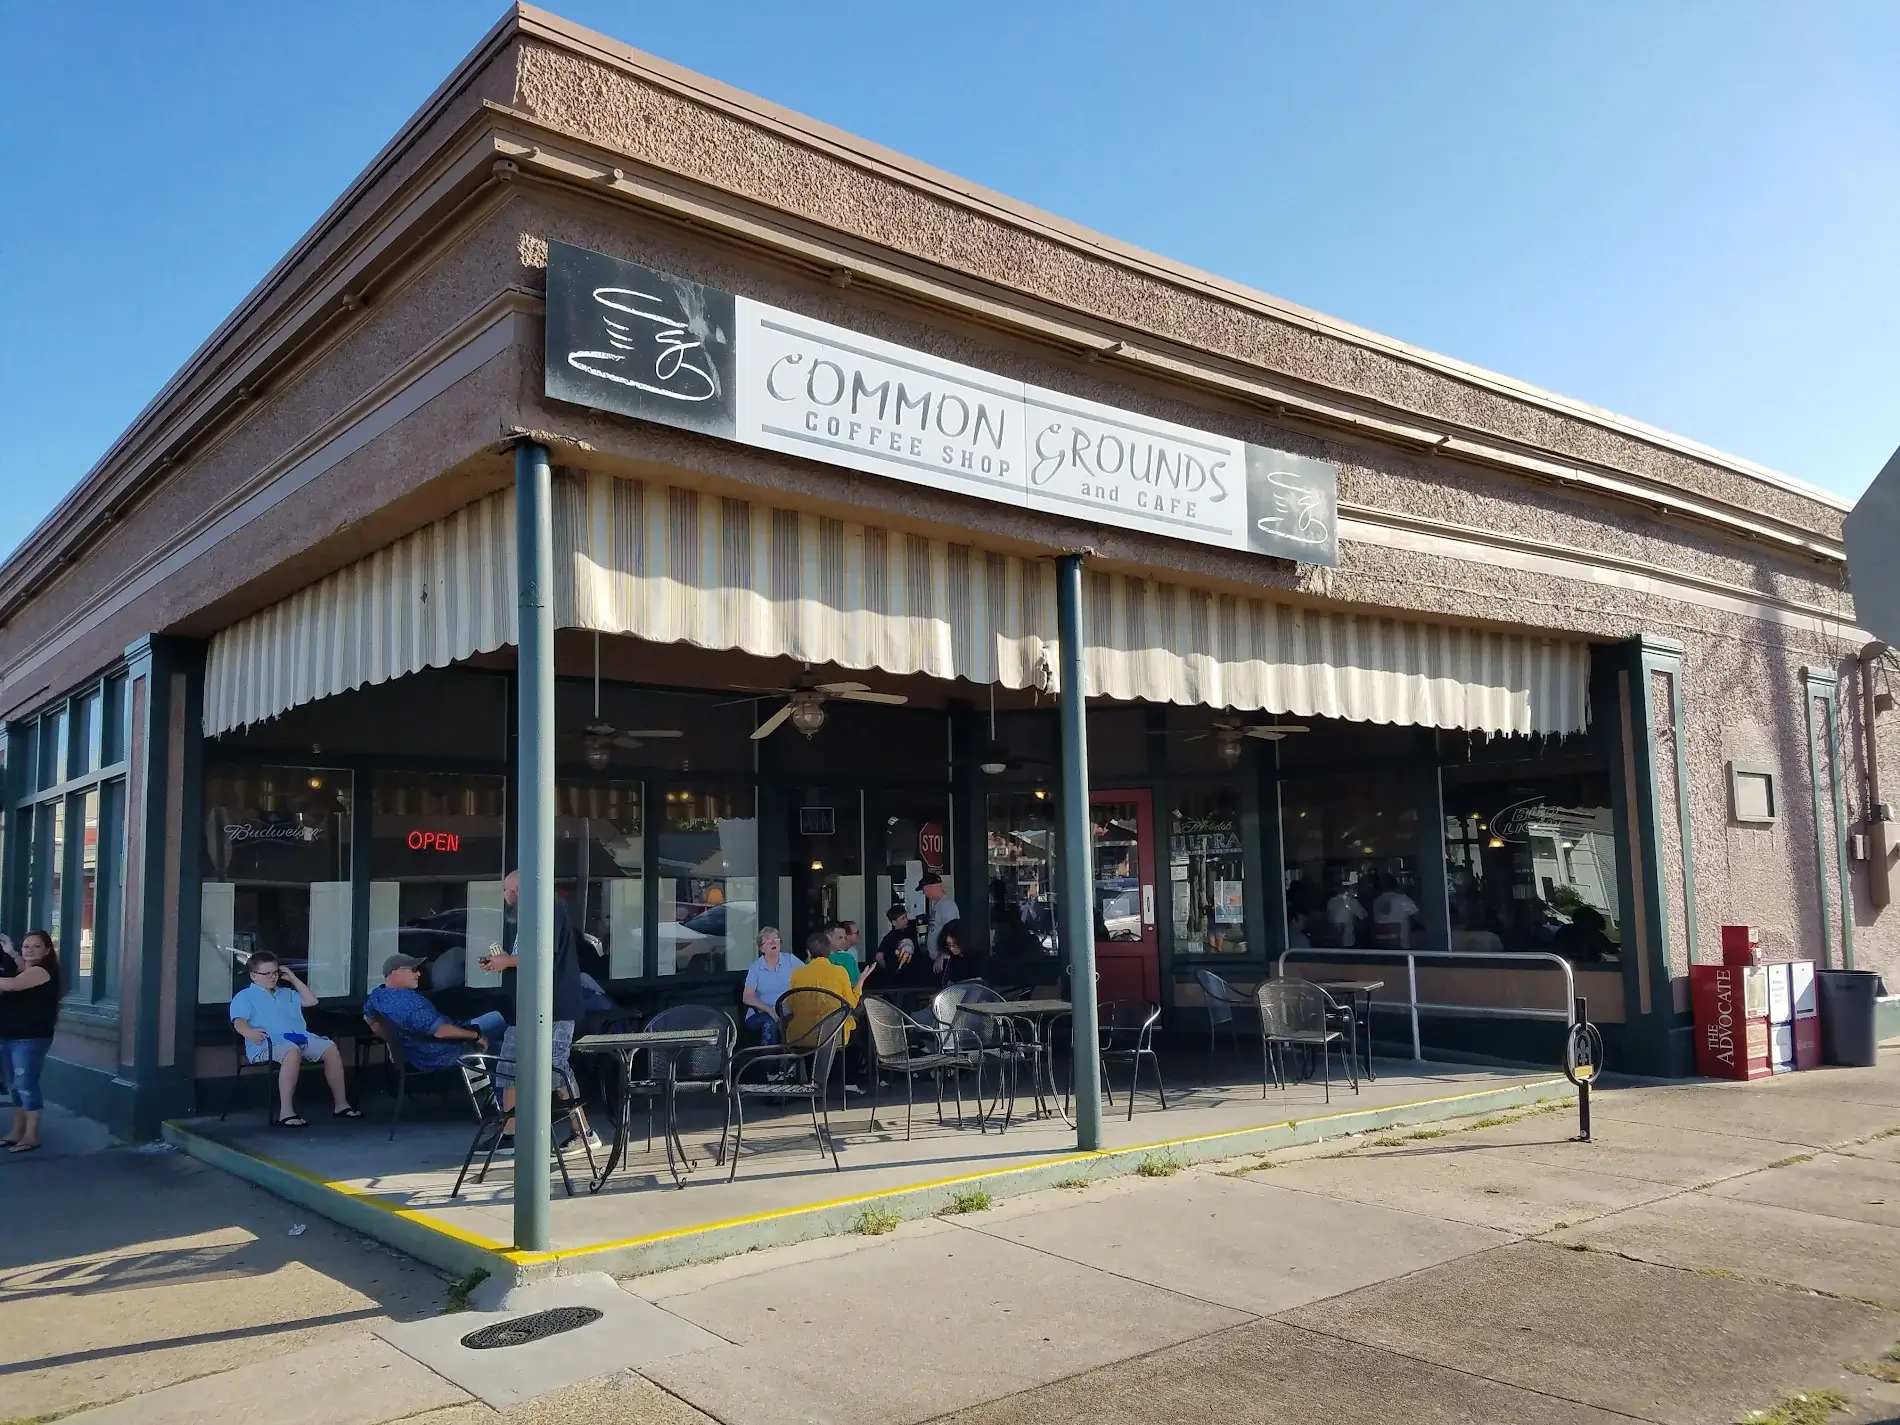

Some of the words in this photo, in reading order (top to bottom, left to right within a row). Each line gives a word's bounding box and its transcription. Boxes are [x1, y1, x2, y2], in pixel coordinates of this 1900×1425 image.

[766, 353, 1005, 450] COMMON
[1031, 423, 1229, 503] GROUNDS
[805, 411, 923, 457] COFFEE
[942, 446, 1011, 477] SHOP
[1081, 482, 1119, 502] and
[1137, 490, 1197, 519] CAFE
[223, 823, 323, 841] Budweiser
[408, 831, 459, 852] OPEN
[1170, 832, 1243, 852] ULTRA
[1716, 969, 1735, 1067] ADVOCATE
[1708, 1024, 1720, 1051] THE
